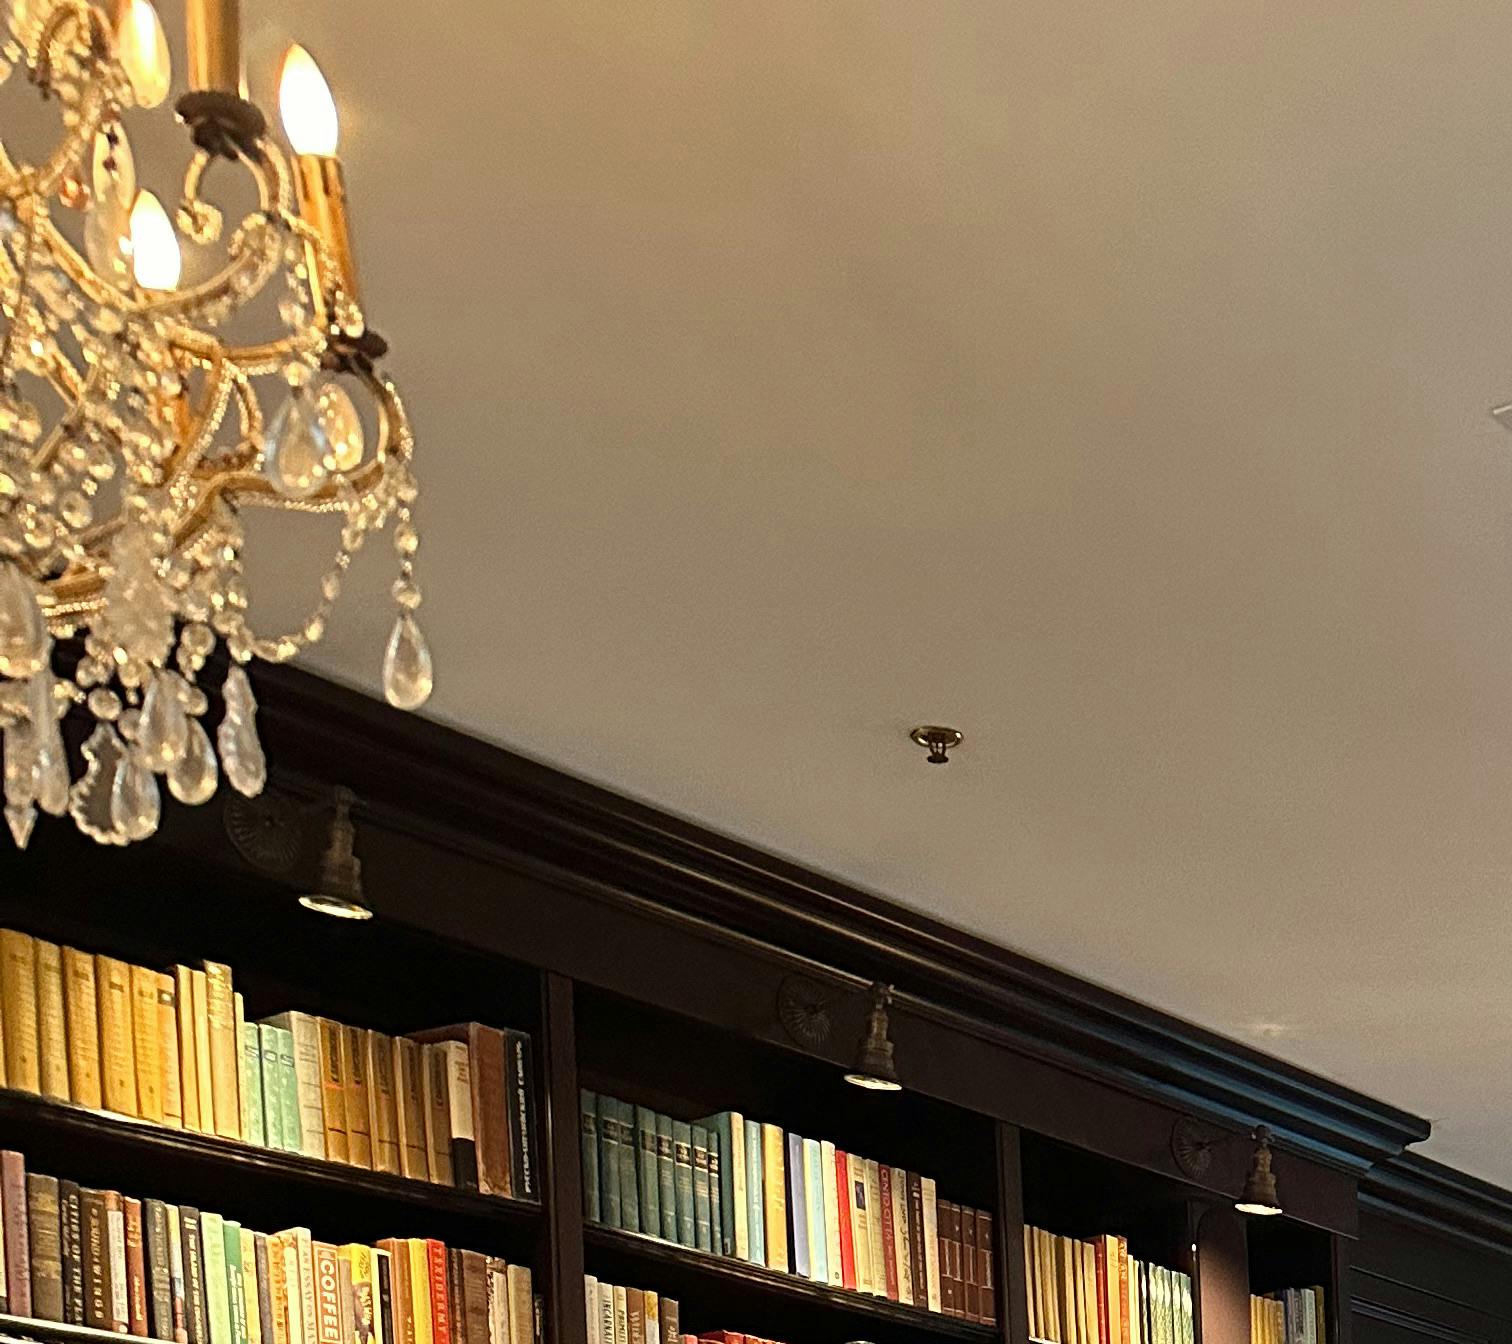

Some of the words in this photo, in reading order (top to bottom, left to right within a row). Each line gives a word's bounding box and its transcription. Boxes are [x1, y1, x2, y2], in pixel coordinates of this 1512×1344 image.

[72, 1267, 82, 1294] THE
[321, 1259, 339, 1340] COFFEE
[432, 1246, 446, 1333] TAXIDERMY
